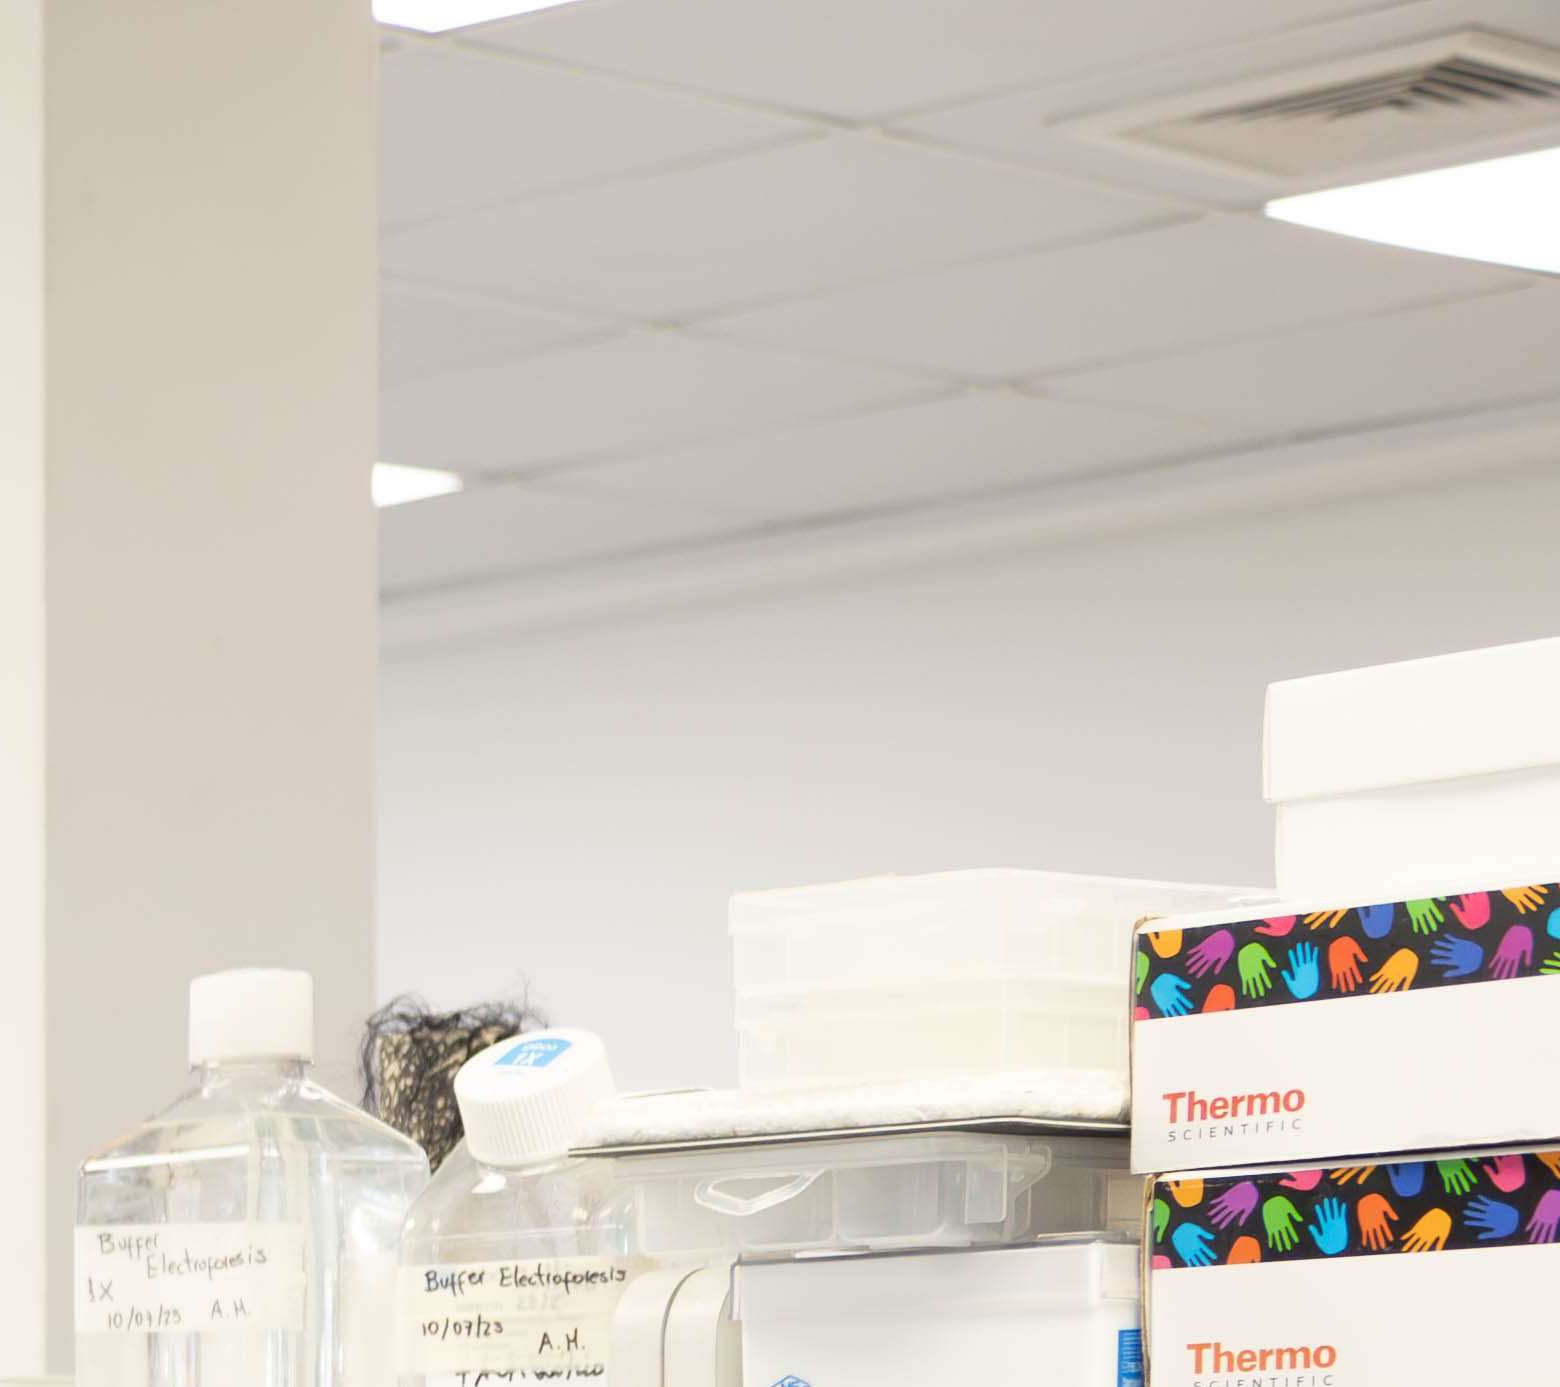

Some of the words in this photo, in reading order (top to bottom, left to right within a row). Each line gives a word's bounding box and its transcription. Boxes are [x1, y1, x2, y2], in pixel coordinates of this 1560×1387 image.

[1162, 1089, 1305, 1124] Thermo
[1168, 1118, 1301, 1142] SCIENTIFIC
[97, 1231, 160, 1260] Buffer
[425, 1269, 486, 1297] Buffer
[1186, 1342, 1336, 1375] Thermo
